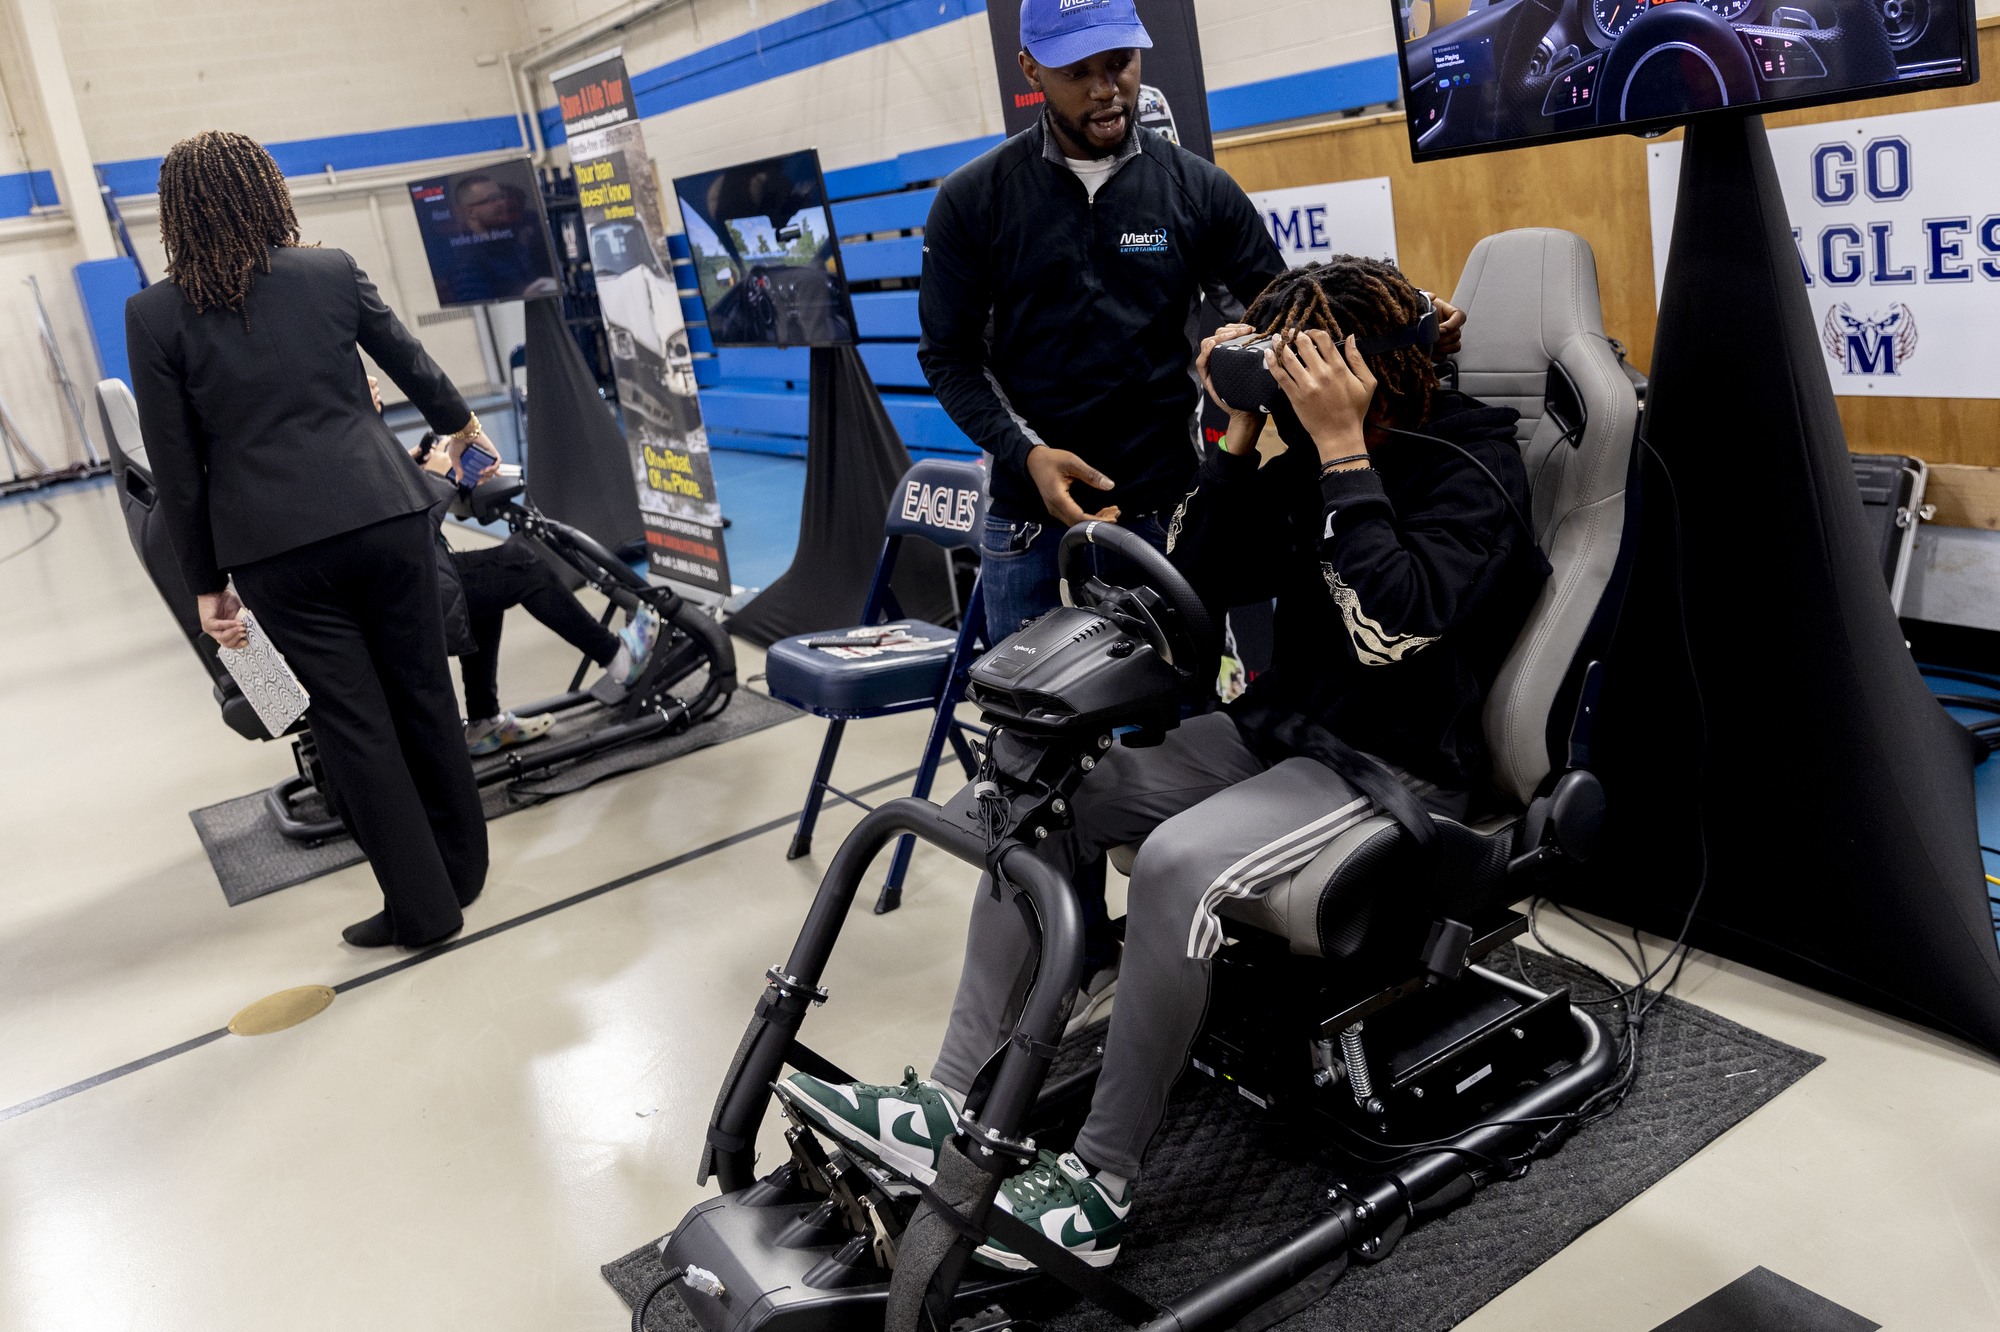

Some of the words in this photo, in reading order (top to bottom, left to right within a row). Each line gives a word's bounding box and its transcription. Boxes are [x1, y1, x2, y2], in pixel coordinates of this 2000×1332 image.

[1061, 3, 1109, 17] ENTERTAINMENT
[560, 94, 582, 121] Save
[586, 83, 605, 112] Life
[602, 79, 624, 107] Tour
[1014, 91, 1045, 108] Respon
[574, 164, 594, 185] Your
[593, 158, 614, 181] brain
[1810, 135, 1913, 207] GO
[580, 183, 606, 208] doesn't
[606, 182, 631, 204] know
[1120, 229, 1167, 245] Matrix
[1259, 203, 1331, 253] ME
[1791, 213, 2000, 288] GLES
[1842, 332, 1901, 376] M
[644, 446, 657, 467] On
[664, 450, 694, 477] Road,
[649, 468, 662, 490] Off
[671, 472, 704, 499] Phone.
[902, 481, 979, 532] EAGLES
